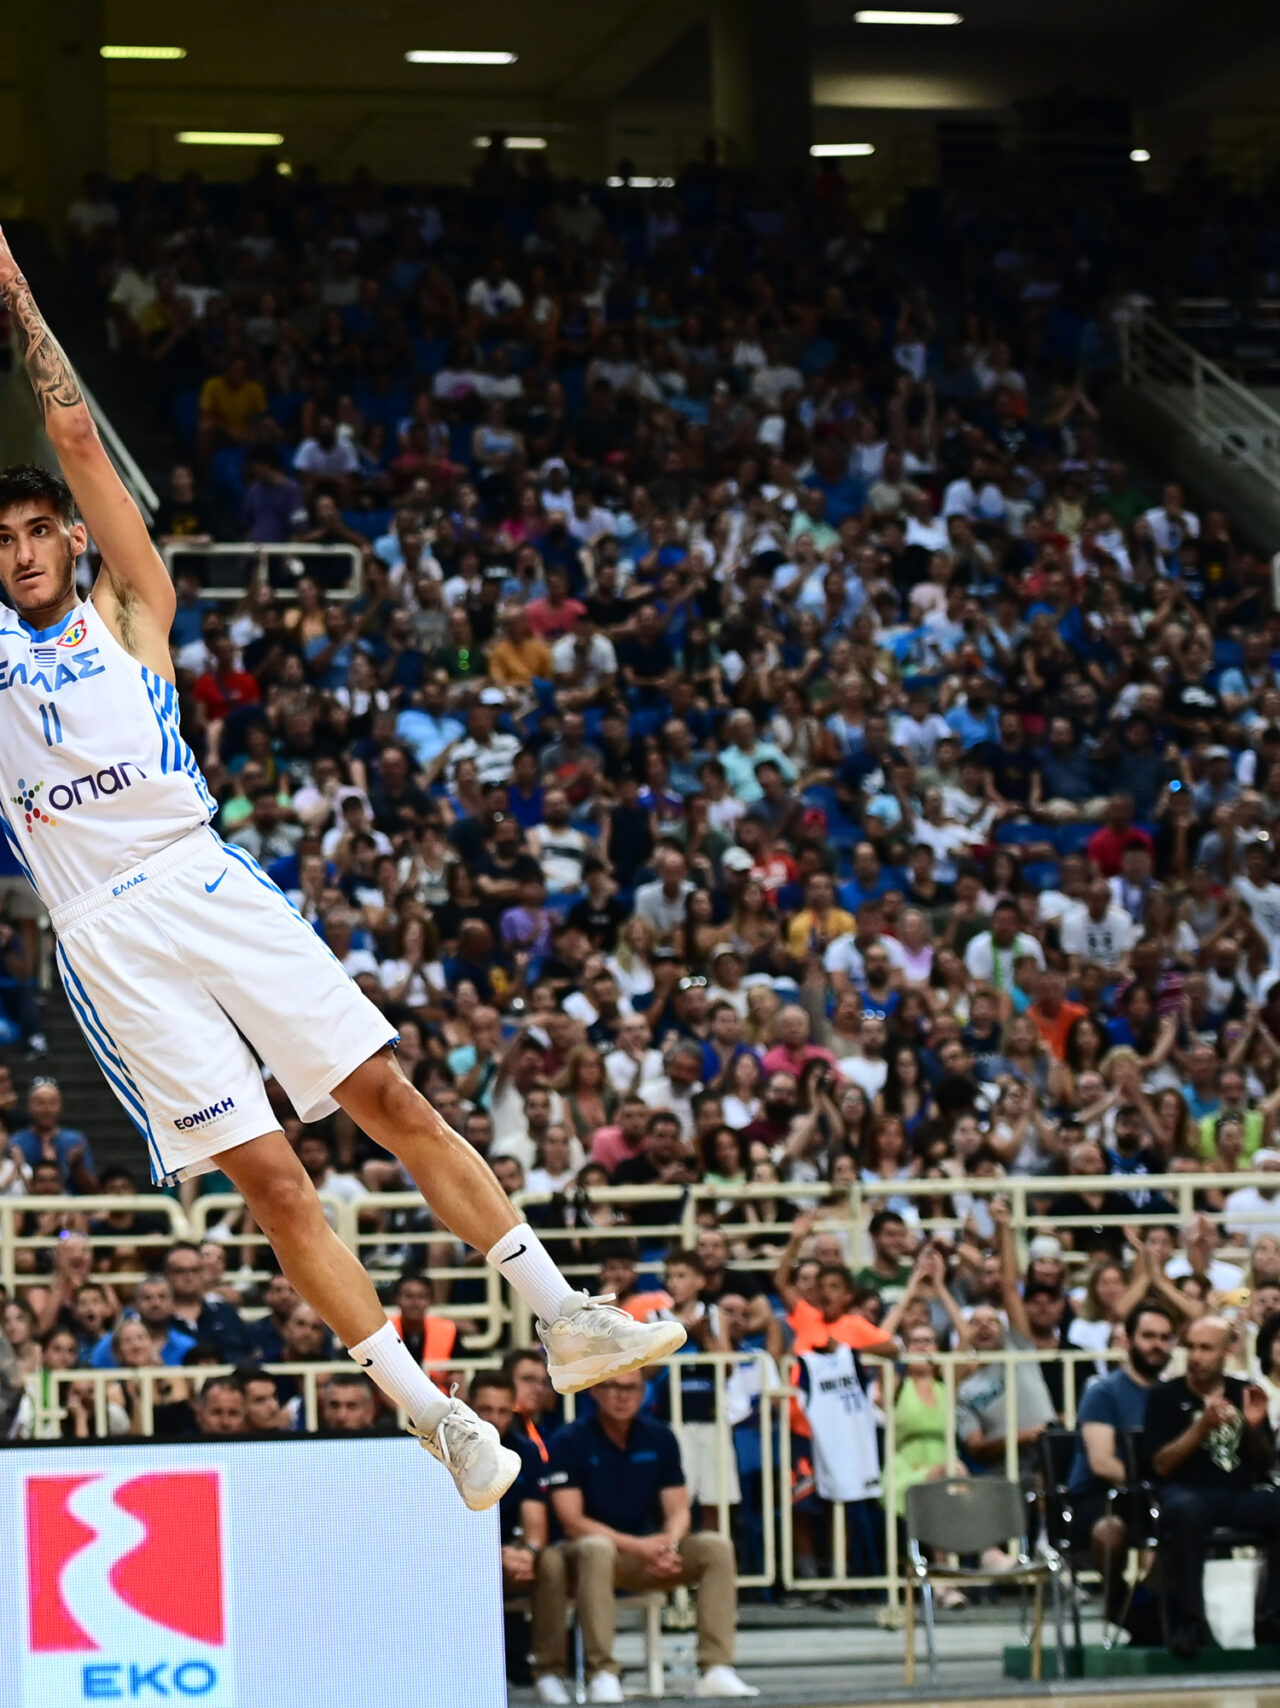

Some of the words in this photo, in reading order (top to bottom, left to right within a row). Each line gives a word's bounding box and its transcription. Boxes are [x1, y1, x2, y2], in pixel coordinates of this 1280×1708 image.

[38, 701, 63, 747] 11
[112, 872, 147, 896] ΕΛΛΑΣ
[82, 1660, 218, 1700] EKO
